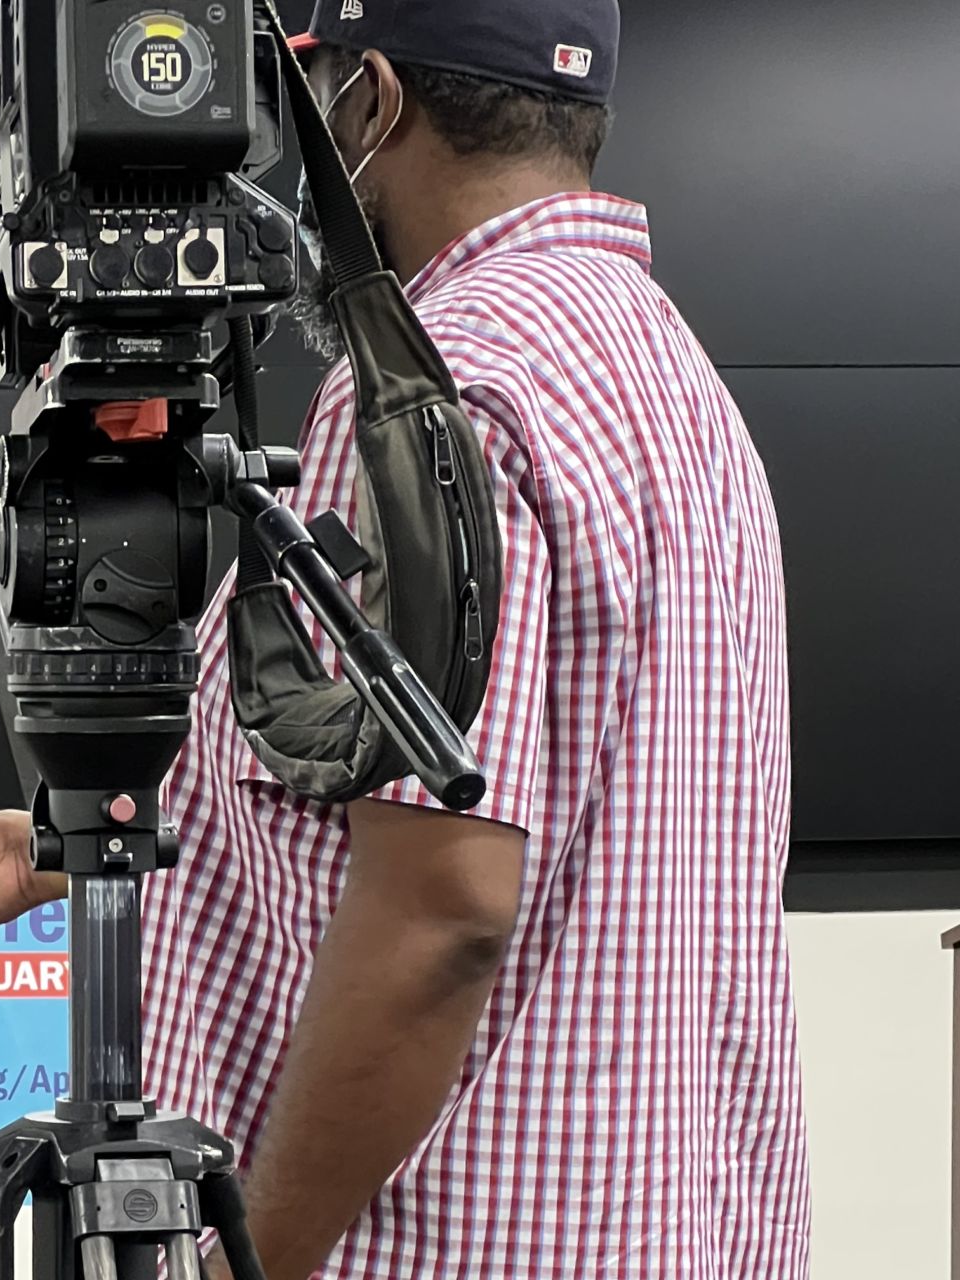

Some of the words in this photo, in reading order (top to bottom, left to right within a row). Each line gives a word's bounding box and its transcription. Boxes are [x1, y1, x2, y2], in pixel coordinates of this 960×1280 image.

[147, 43, 176, 51] HYPER
[141, 52, 182, 82] 150
[58, 537, 65, 546] 2
